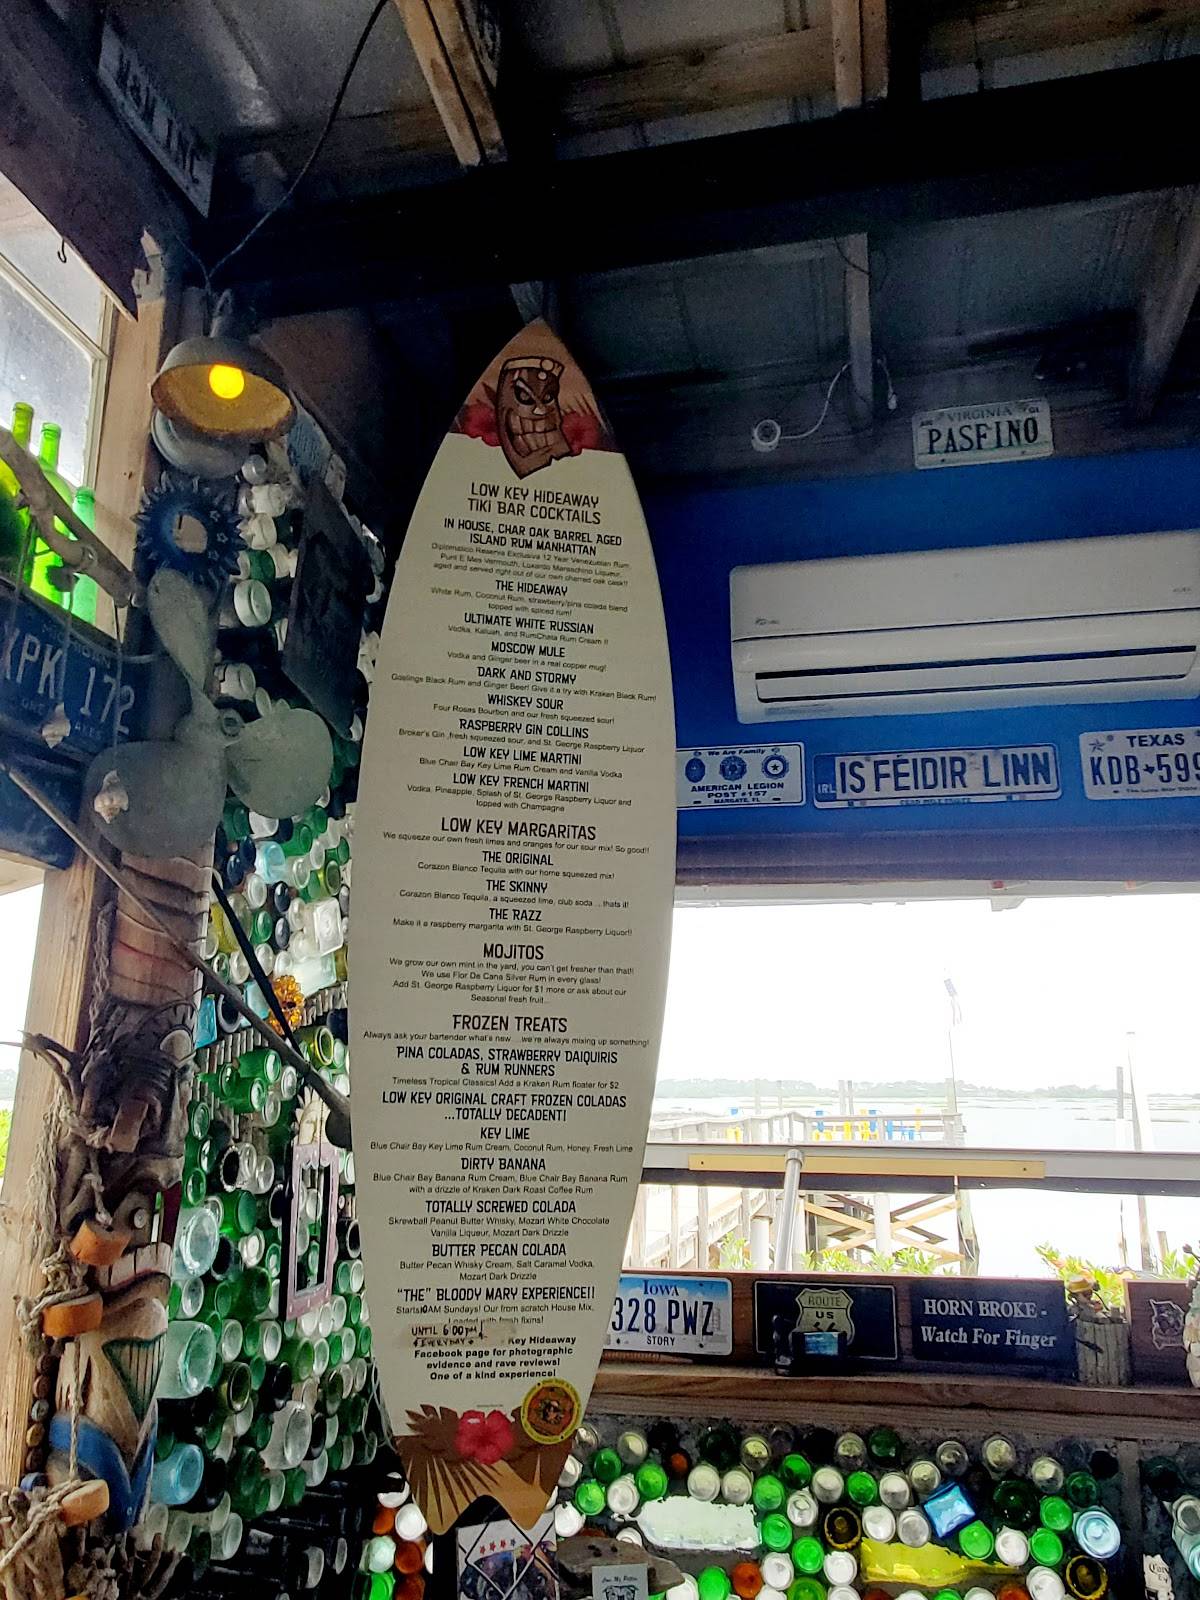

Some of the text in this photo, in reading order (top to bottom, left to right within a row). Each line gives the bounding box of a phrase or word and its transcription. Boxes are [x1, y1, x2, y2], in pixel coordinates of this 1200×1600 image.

[928, 417, 1038, 454] PASFINO
[470, 481, 599, 508] LOW KEY HIDEAWAY
[467, 497, 601, 524] TIKI BAR COCKTAILS
[443, 517, 454, 528] IN
[497, 523, 525, 535] CHAR
[528, 526, 549, 538] OAK
[552, 529, 593, 542] BARREL
[595, 533, 622, 546] AGED
[469, 533, 596, 555] ISLAND RUM MANHATTAN
[495, 579, 567, 596] THE HIDEAWAY
[464, 612, 594, 633] ULTIMATE WHITE RUSSIAN
[490, 641, 565, 657] MOSCOW MULE
[476, 666, 576, 684] DARK AND STORMY
[80, 667, 135, 736] 172
[487, 693, 563, 709] WHISKEY SOUR
[458, 718, 588, 738] RASPBERRY GIN COLLINS
[1126, 733, 1185, 748] TEXAS
[463, 745, 581, 764] LOW KEY LIME MARTINI
[817, 784, 835, 794] IRL
[840, 760, 865, 794] IS
[982, 752, 1052, 788] LINN
[452, 772, 588, 792] LOW KEY FRENCH MARTINI
[690, 782, 784, 792] AMERICAN LEGION
[741, 790, 768, 798] #157
[441, 816, 596, 840] LOW KEY MARGARITAS
[481, 850, 554, 865] THE ORIGINAL
[485, 879, 548, 893] THE SKINNY
[488, 907, 542, 921] THE RAZZ
[483, 943, 544, 959] MOJITOS
[451, 1014, 567, 1032] FROZEN TREATS
[395, 1046, 424, 1058] PINA
[487, 1048, 561, 1061] STRAWBERRY
[563, 1050, 618, 1064] DAIQUIRIS
[460, 1062, 555, 1076] & RUM RUNNERS
[382, 1091, 626, 1107] LOW KEY ORIGINAL CRAFT FROZEN COLADAS
[480, 1126, 530, 1139] KEY LIME
[460, 1157, 546, 1170] DIRTY BANANA
[424, 1200, 576, 1212] TOTALLY SCREWED COLADA
[388, 1216, 427, 1224] Skrewball
[429, 1216, 458, 1224] Peanut
[460, 1216, 484, 1224] Butter
[518, 1216, 545, 1224] Mozart
[547, 1216, 569, 1224] White
[571, 1216, 609, 1224] Chocolate
[431, 1243, 566, 1256] BUTTER PECAN COLADA
[399, 1260, 424, 1269] Butter
[426, 1260, 452, 1268] Pecan
[454, 1260, 483, 1269] Whisky
[516, 1259, 531, 1268] Salt
[533, 1259, 566, 1267] Caramel
[459, 1271, 536, 1280] Mozart Dark Drizzle
[435, 1287, 481, 1301] BLOODY
[485, 1287, 518, 1300] MARY
[808, 1296, 841, 1306] ROUTE
[612, 1296, 714, 1336] 328 PWZ
[815, 1310, 834, 1319] US
[924, 1299, 974, 1316] HORN
[978, 1300, 1037, 1318] BROKE
[412, 1326, 438, 1336] UNTIL
[921, 1326, 1057, 1350] Watch For Finger
[529, 1336, 576, 1344] Hideaway
[646, 1335, 676, 1346] STORY
[414, 1346, 573, 1358] Facebook page for photographic
[426, 1360, 471, 1368] evidence
[474, 1359, 492, 1367] and
[429, 1371, 450, 1380] One
[452, 1371, 463, 1379] of
[474, 1370, 496, 1379] kind
